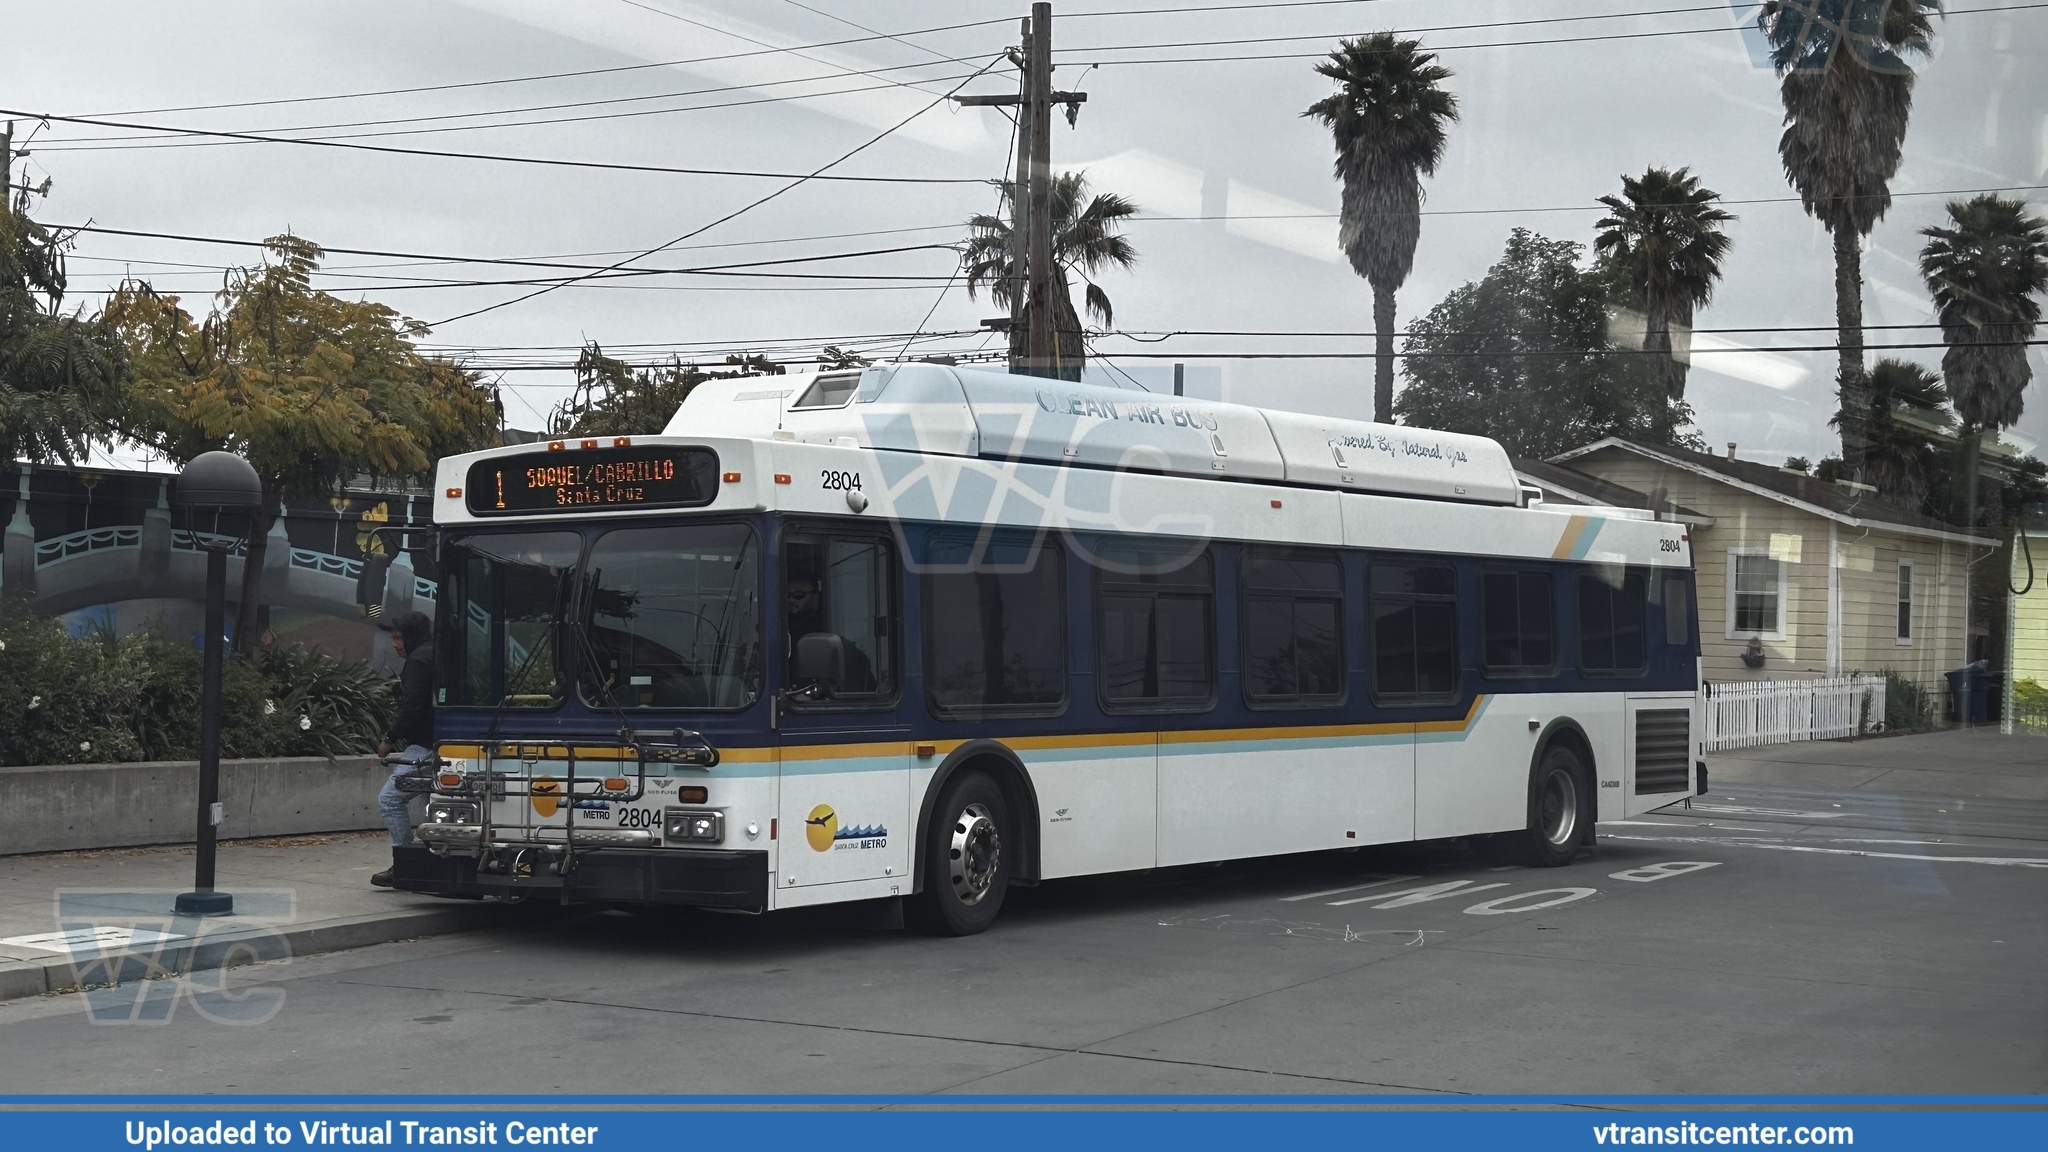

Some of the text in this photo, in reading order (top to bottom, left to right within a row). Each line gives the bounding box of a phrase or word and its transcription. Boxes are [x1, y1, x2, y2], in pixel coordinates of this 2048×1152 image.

[1128, 402, 1165, 426] AIR
[1171, 406, 1218, 431] BUS
[526, 458, 675, 488] SOQUEL/CABRILLO
[821, 469, 862, 491] 2804
[496, 470, 506, 509] 1
[556, 484, 644, 505] Santa Cruz
[1660, 538, 1680, 552] 2804
[583, 810, 610, 820] METRO
[618, 807, 663, 828] 2804
[861, 839, 887, 849] METRO
